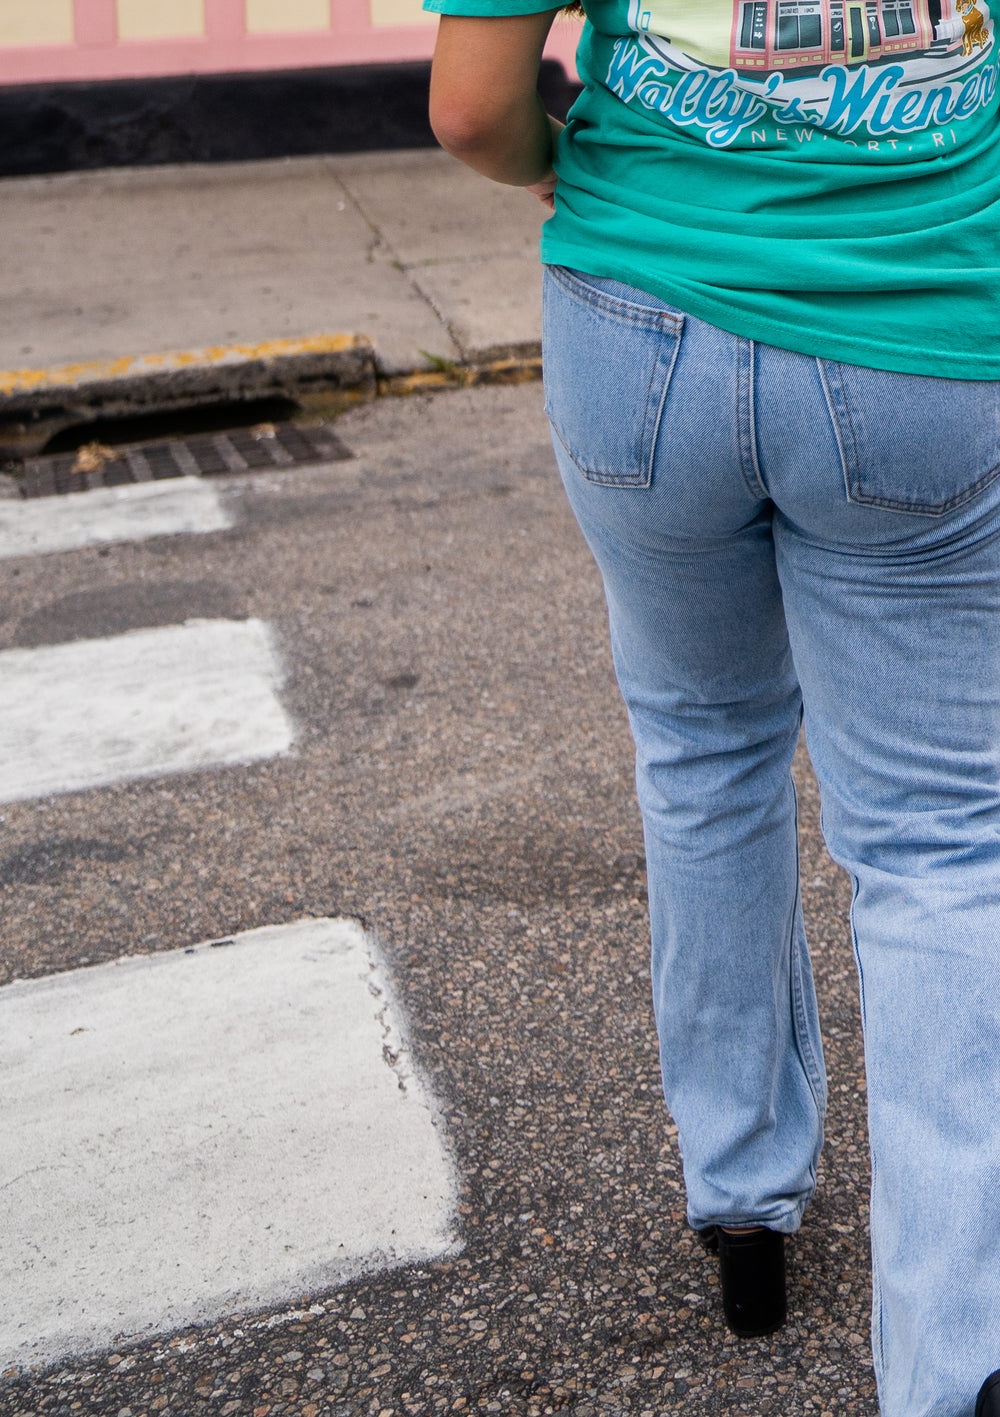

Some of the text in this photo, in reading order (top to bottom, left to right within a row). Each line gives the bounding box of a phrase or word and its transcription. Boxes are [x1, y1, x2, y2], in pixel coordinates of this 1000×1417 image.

[606, 37, 818, 147] Wally's
[751, 127, 956, 152] NEWRT, RI
